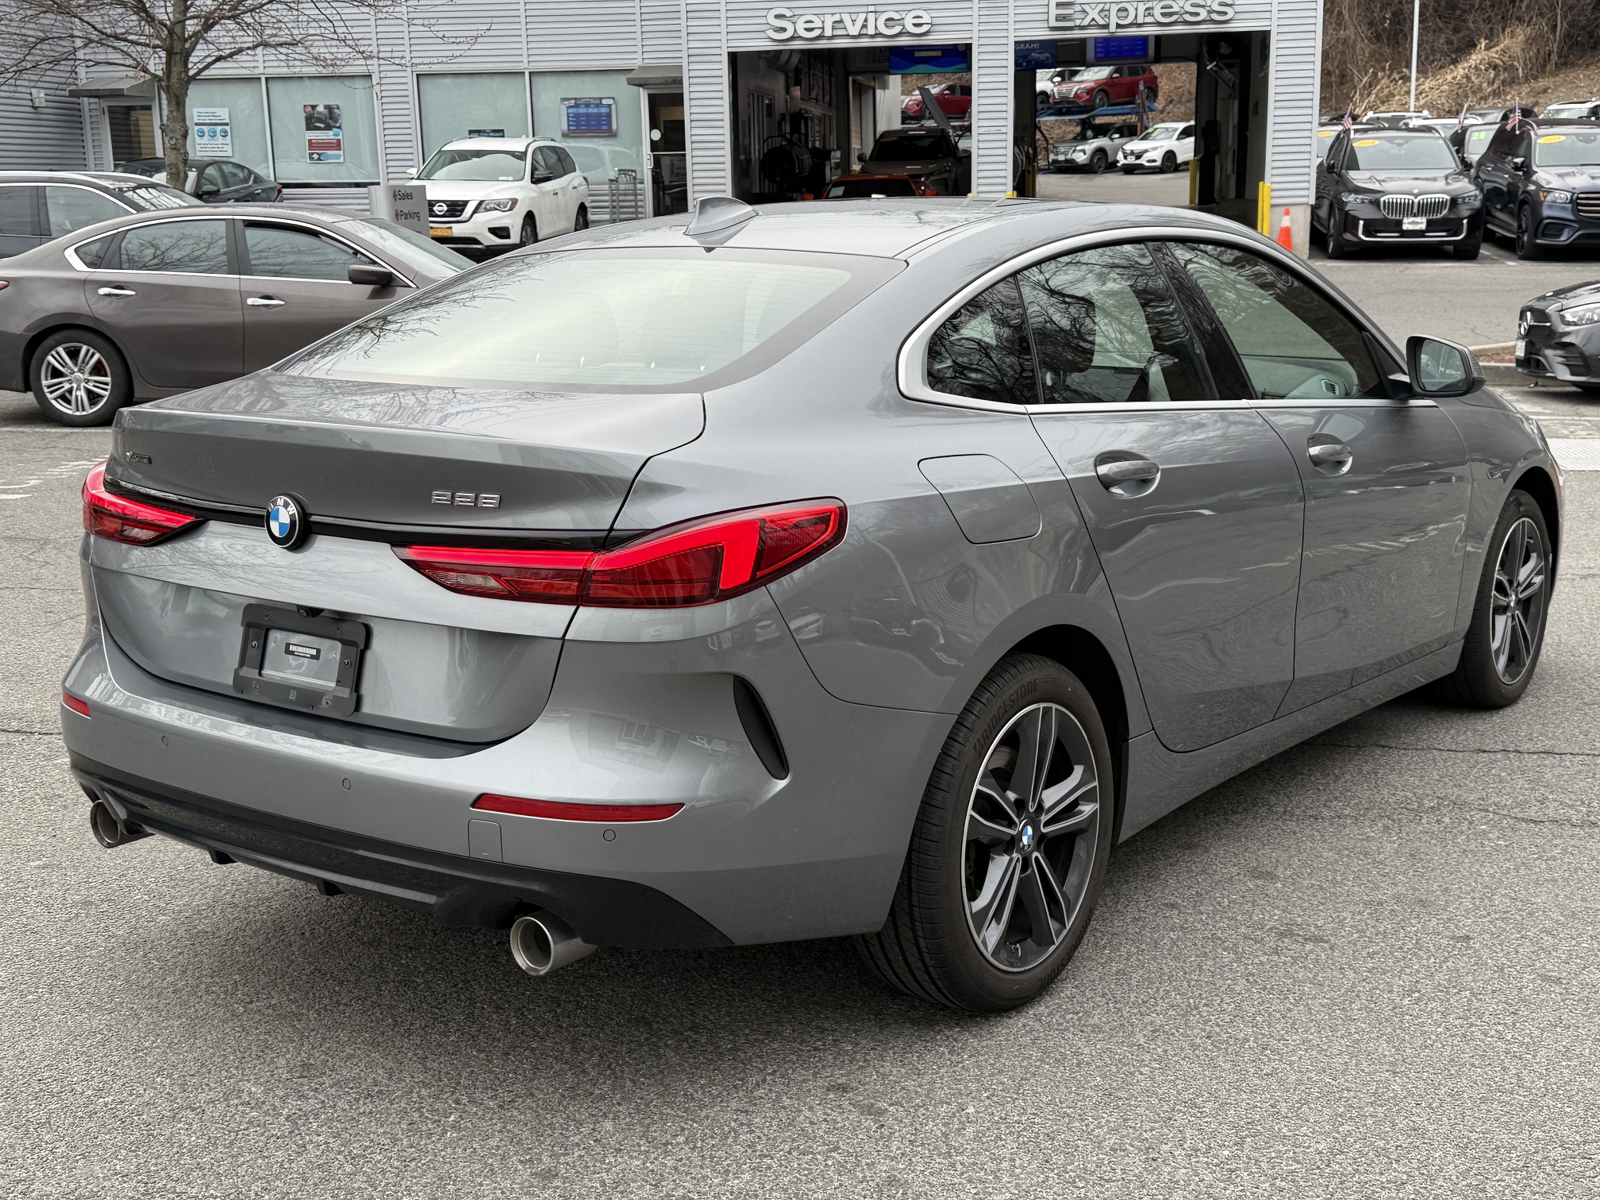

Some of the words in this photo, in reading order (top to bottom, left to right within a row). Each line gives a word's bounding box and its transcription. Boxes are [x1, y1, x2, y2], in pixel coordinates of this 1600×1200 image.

[765, 6, 932, 40] Service
[1048, 0, 1235, 33] Express
[397, 189, 413, 201] Sales
[400, 209, 421, 221] Parking
[431, 490, 500, 508] 228
[973, 678, 1039, 757] BRIDGESTONE
